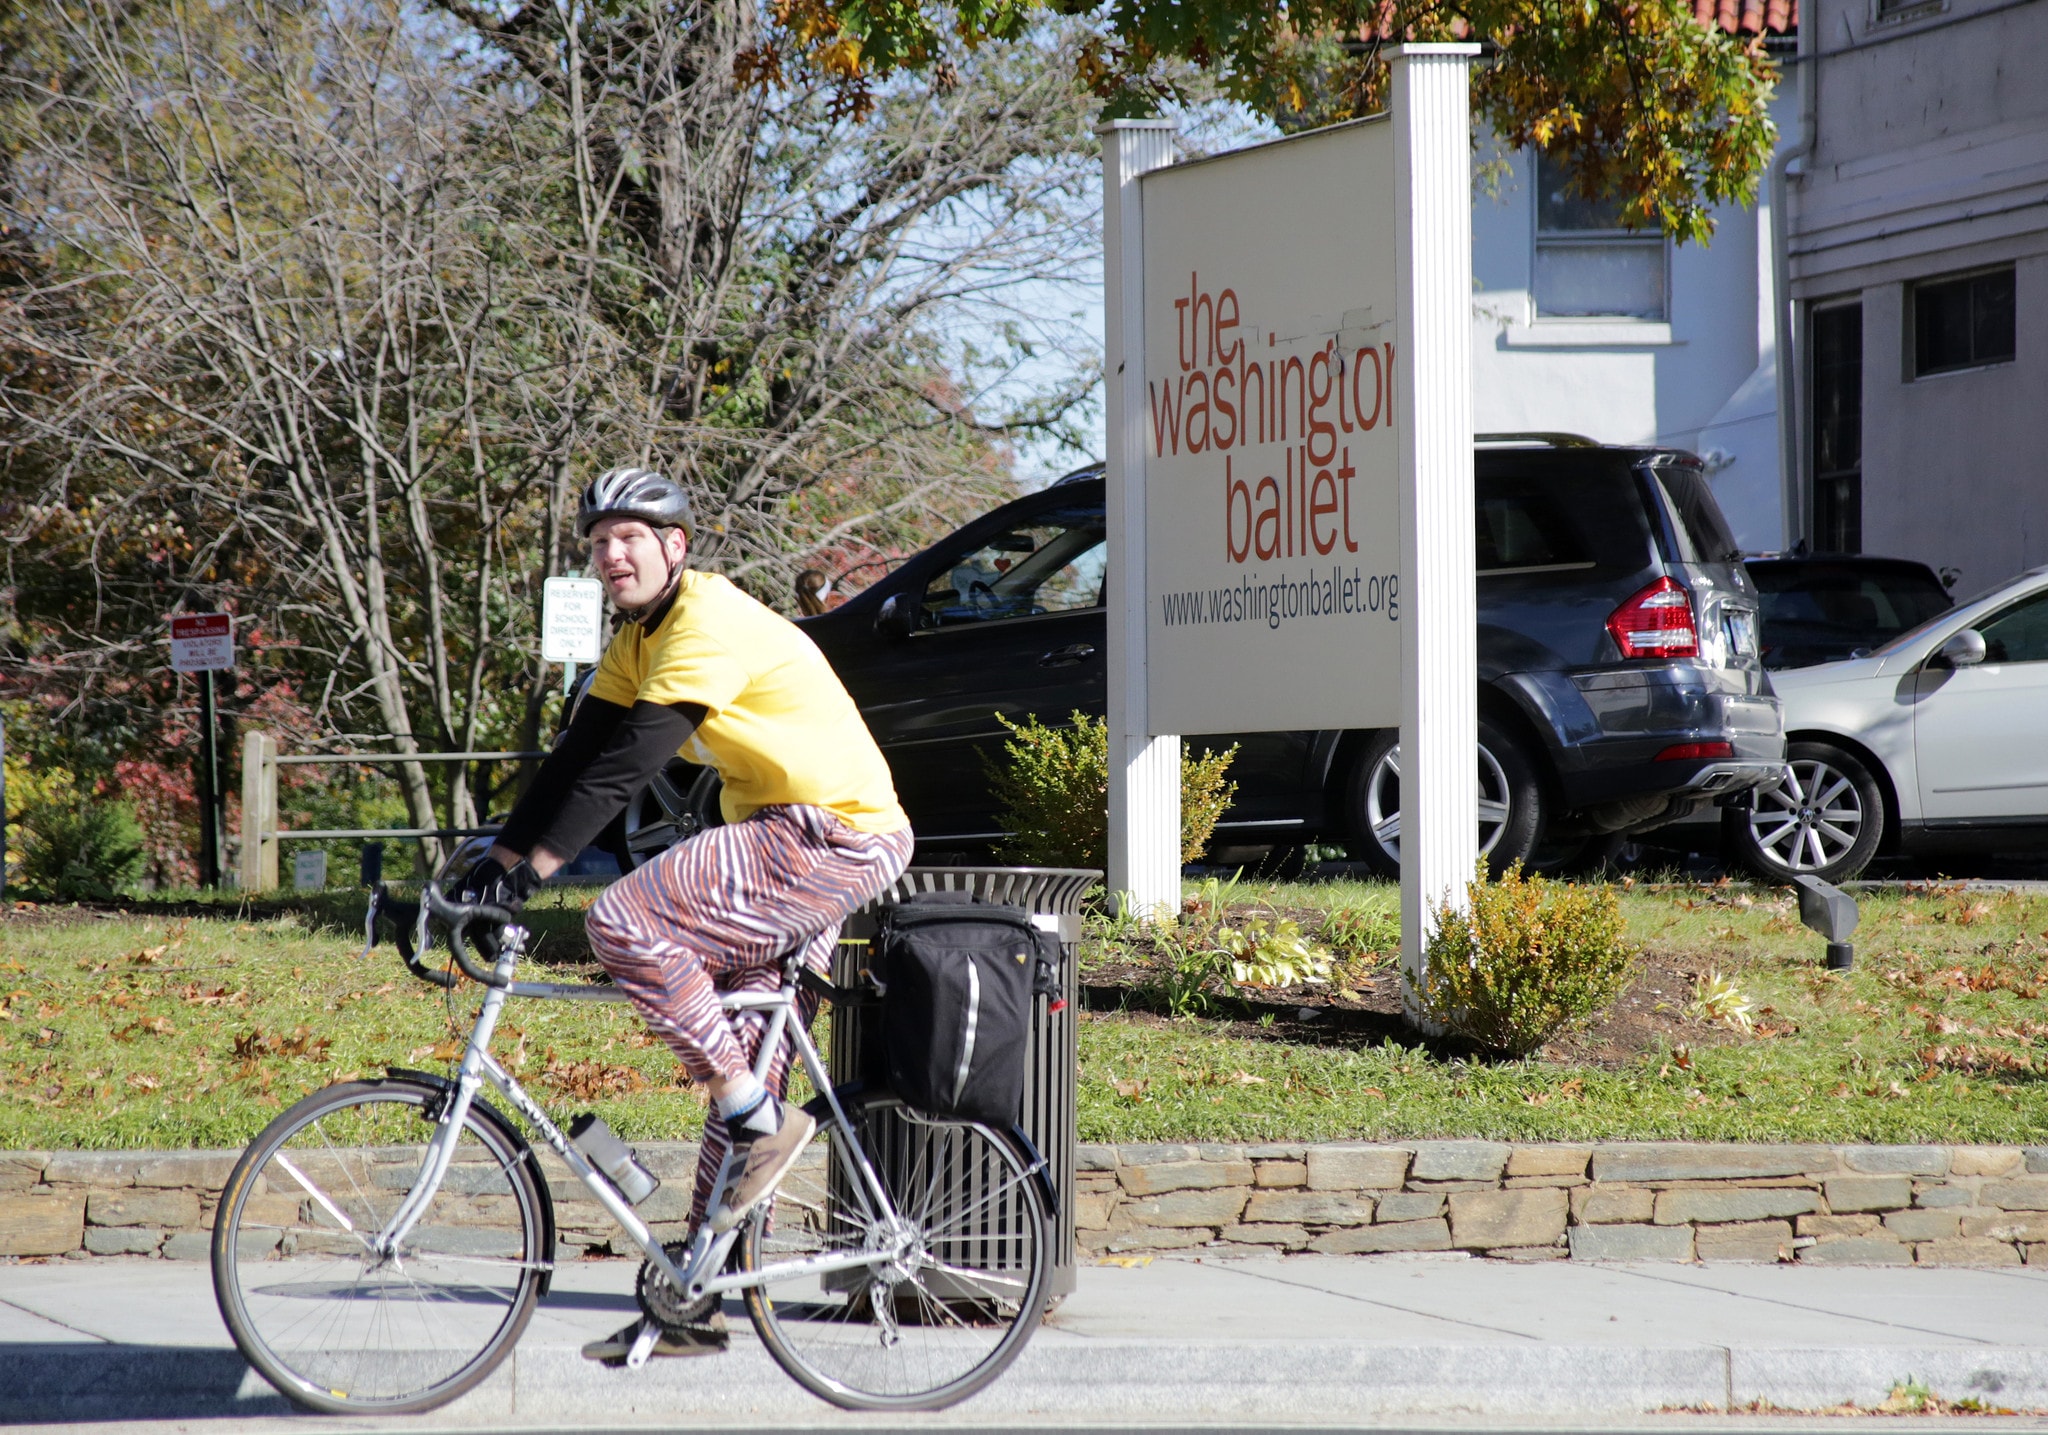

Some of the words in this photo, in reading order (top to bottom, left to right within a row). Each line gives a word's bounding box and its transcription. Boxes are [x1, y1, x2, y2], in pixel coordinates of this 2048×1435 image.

[1174, 270, 1240, 372] the
[1226, 444, 1359, 564] ballet
[550, 589, 596, 599] RESERVED
[1162, 566, 1399, 630] www.washingtonballet.org
[563, 602, 581, 611] FOR
[195, 618, 207, 626] NO
[554, 614, 589, 624] SCHOOL
[175, 626, 227, 637] TRESPASSING
[550, 626, 593, 636] DIRECTOR
[182, 638, 223, 648] VIOLATORS
[559, 639, 583, 648] ONLY
[178, 657, 227, 666] PROSECUTED
